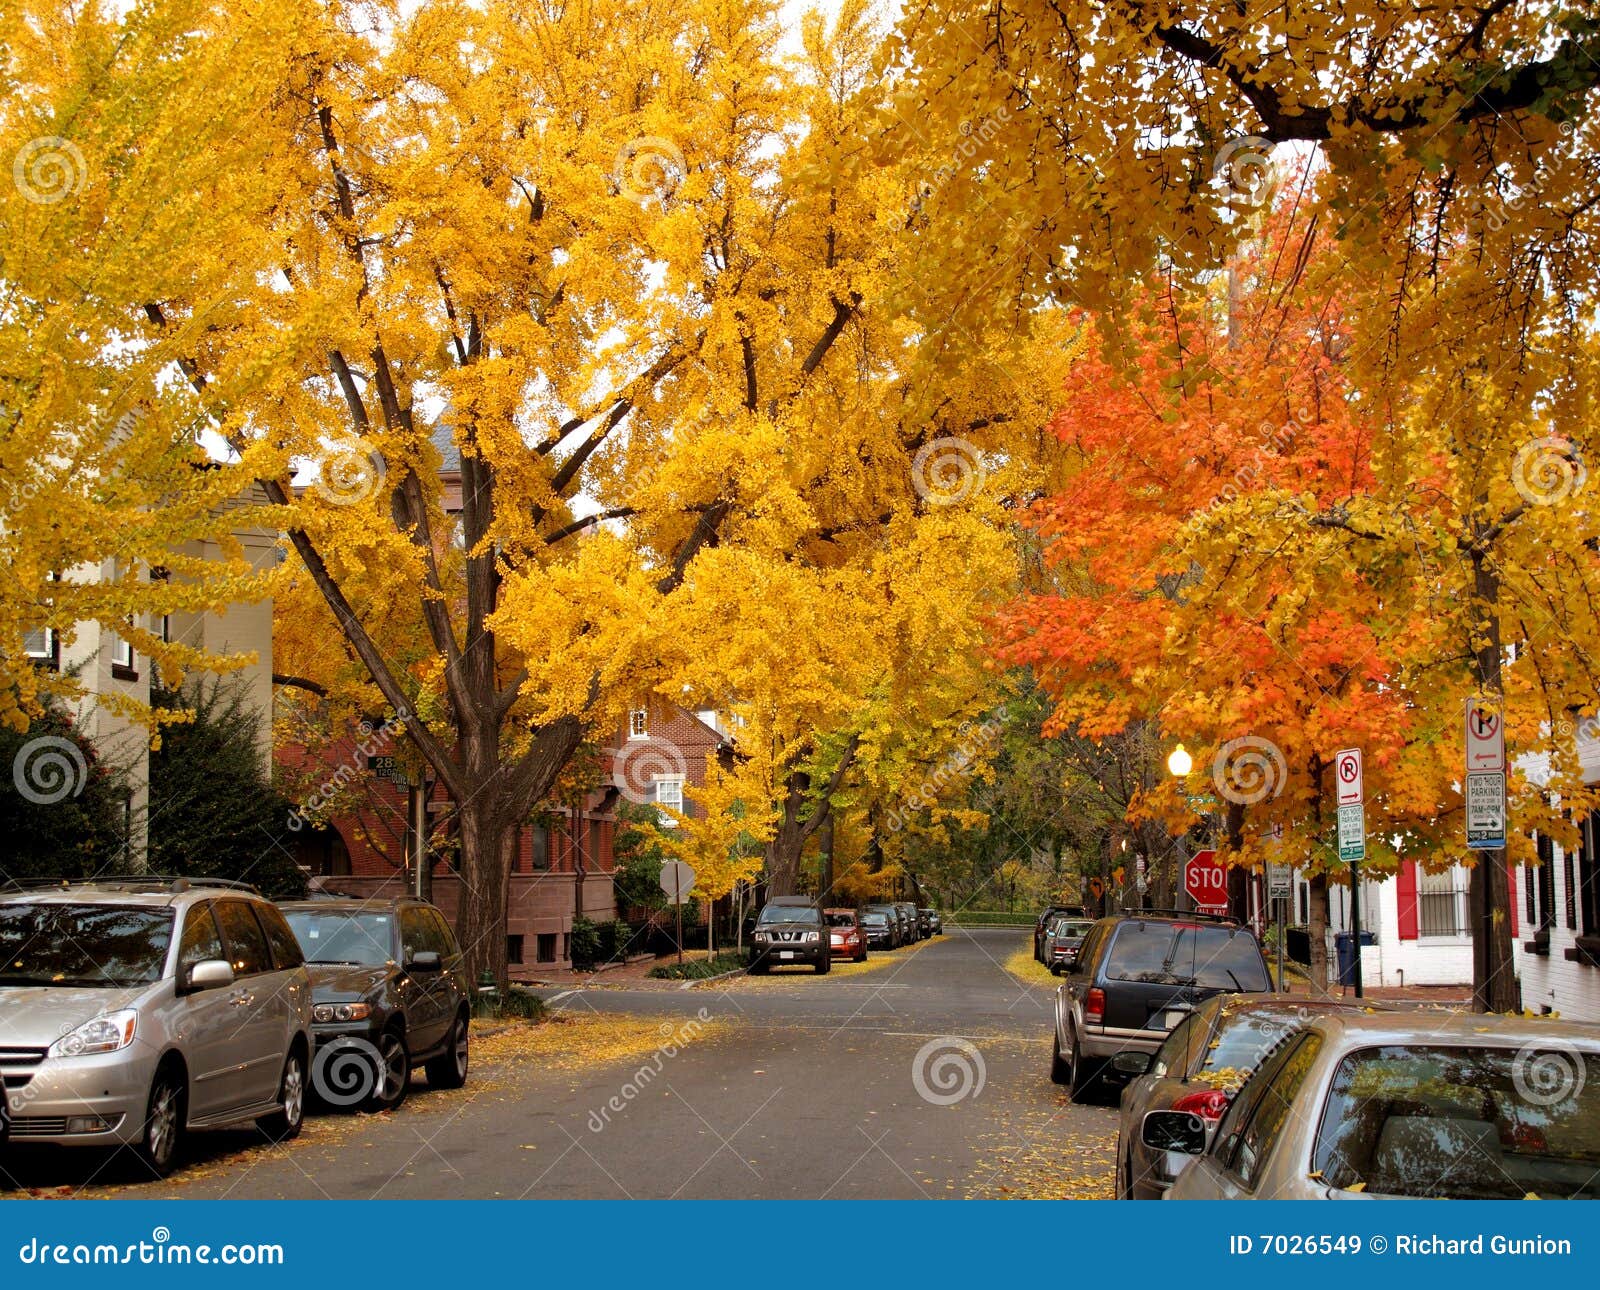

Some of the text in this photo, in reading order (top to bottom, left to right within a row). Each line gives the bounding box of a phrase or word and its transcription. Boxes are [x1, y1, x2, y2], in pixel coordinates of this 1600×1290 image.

[1470, 776, 1501, 786] TWO HOUR
[1471, 786, 1501, 797] PARKING
[1481, 830, 1488, 840] 2
[1189, 867, 1223, 889] STO
[1213, 908, 1226, 916] WAY
